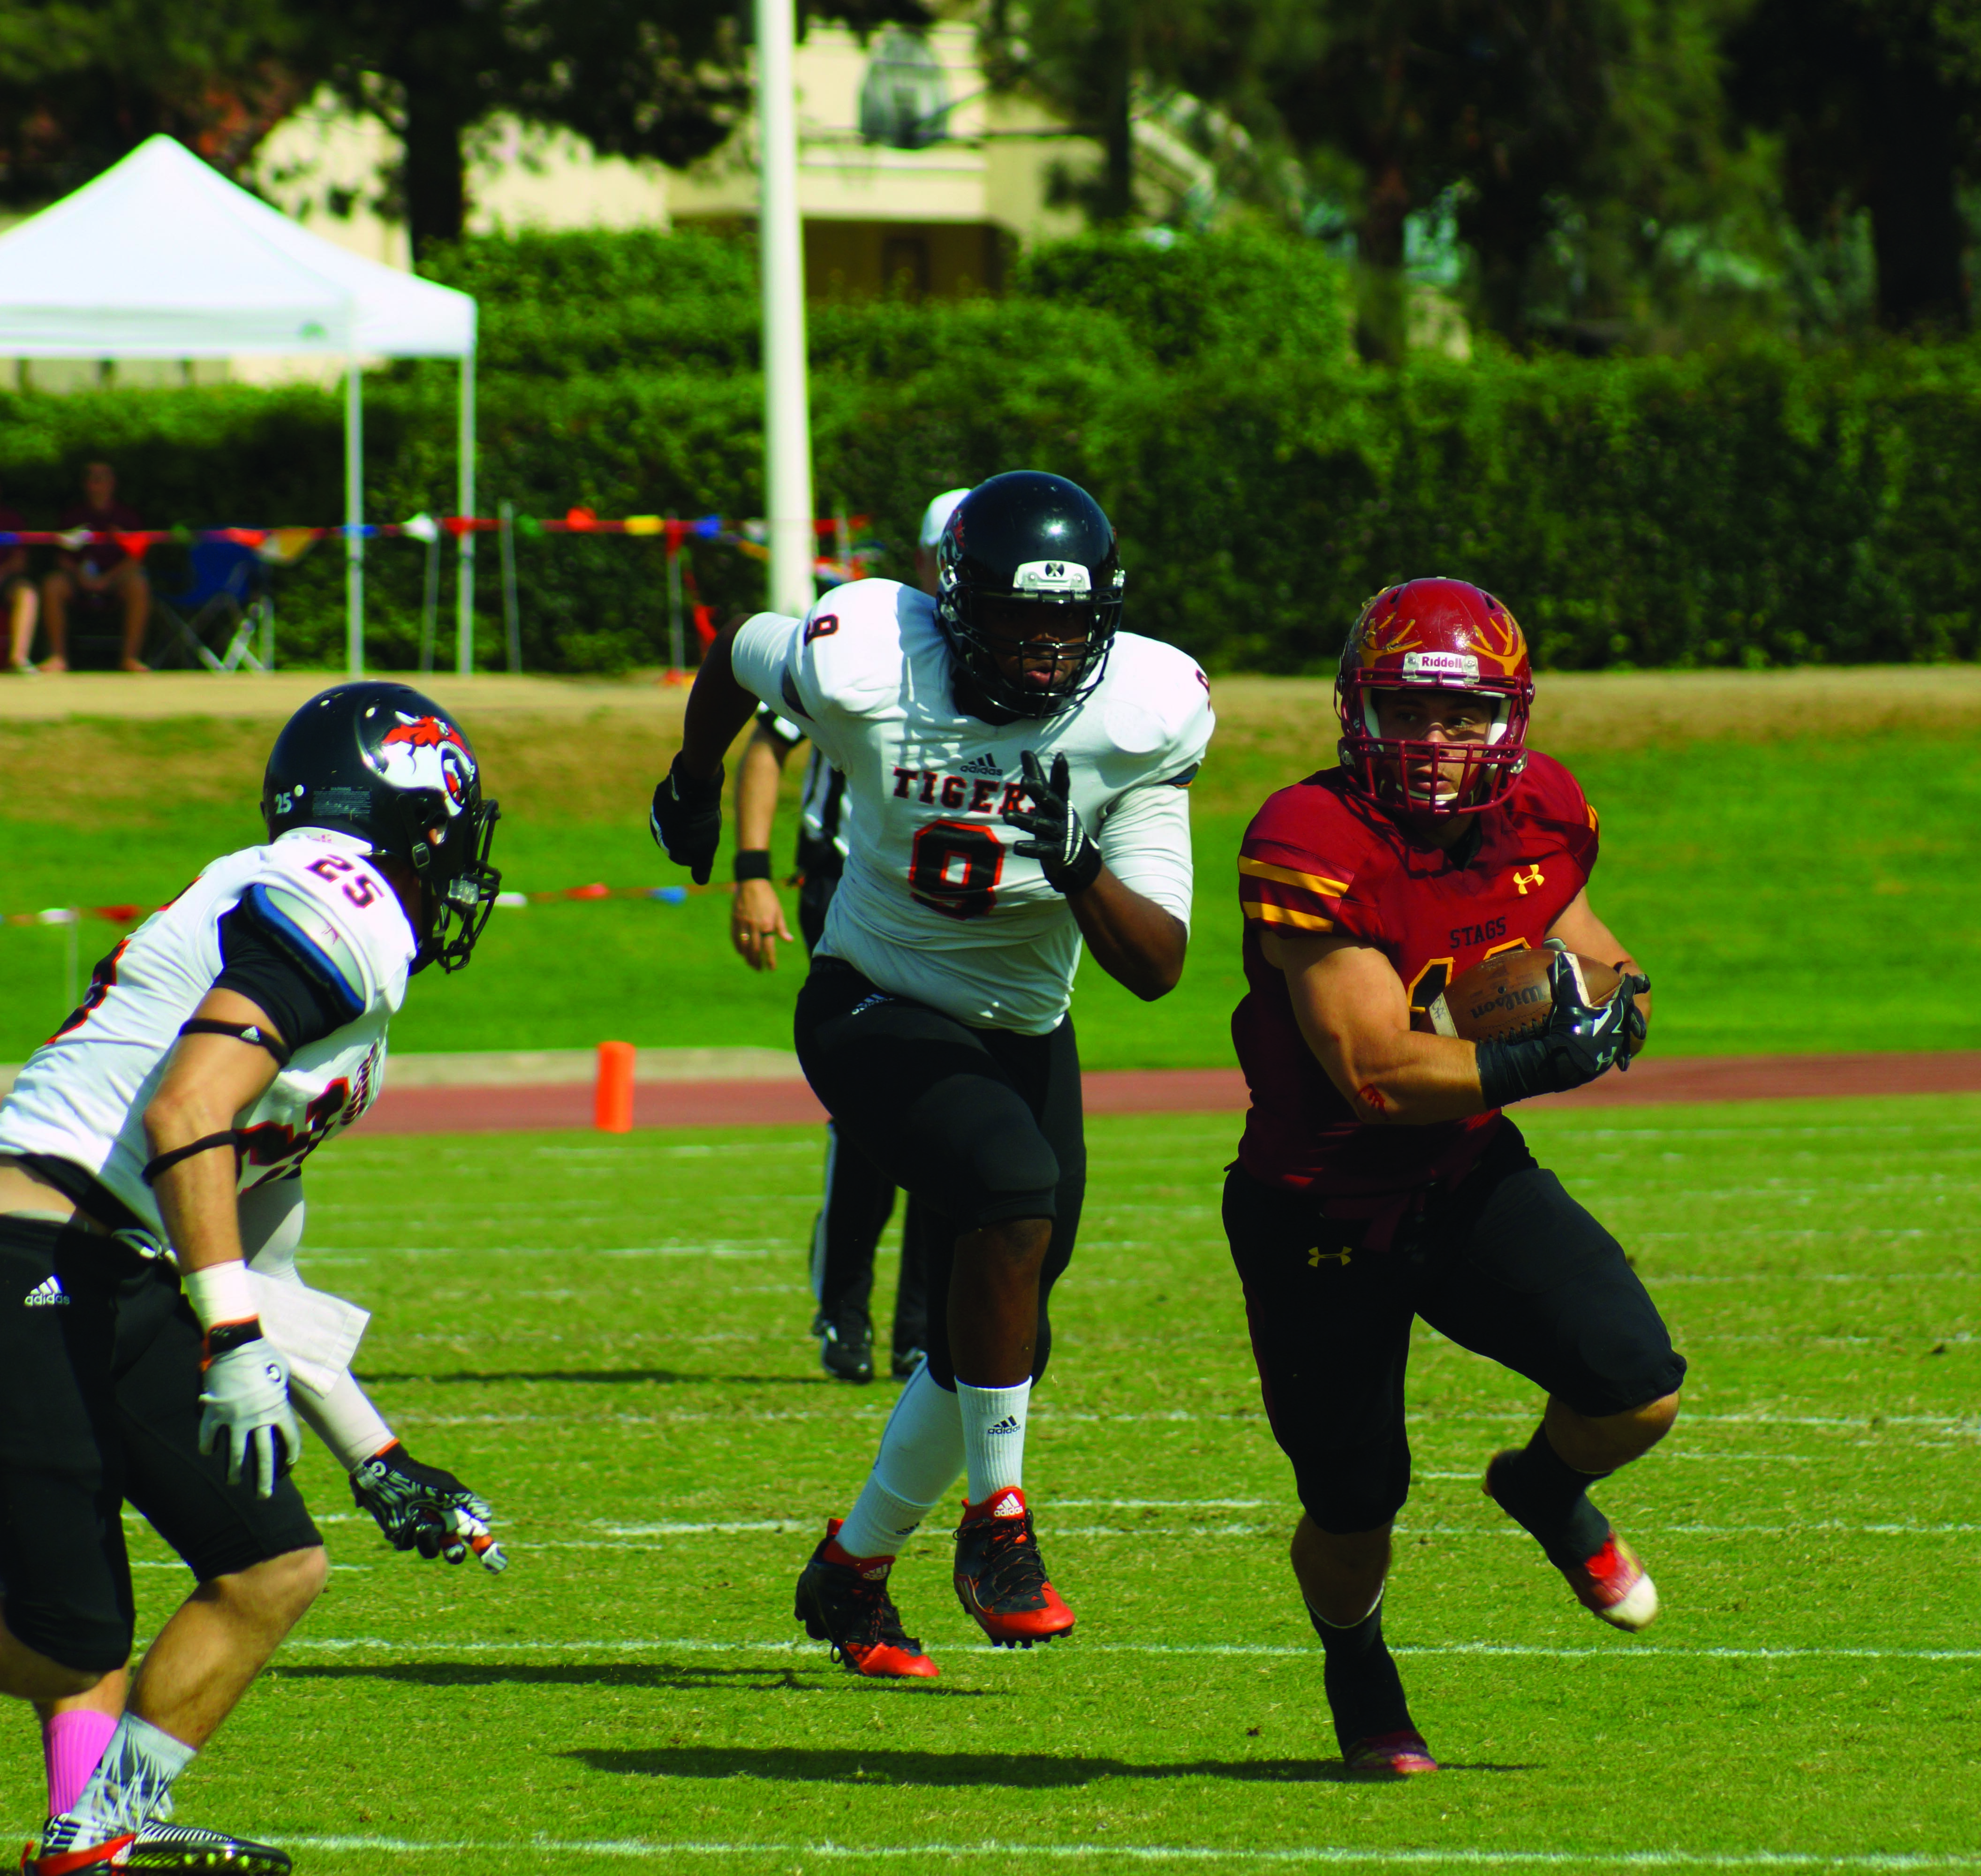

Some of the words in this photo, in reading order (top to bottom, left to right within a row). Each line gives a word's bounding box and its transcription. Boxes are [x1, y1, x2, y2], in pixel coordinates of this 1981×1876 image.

[1422, 656, 1462, 668] Riddell
[960, 765, 1003, 777] adidas
[893, 766, 1036, 816] TIGER
[275, 792, 292, 815] 25
[304, 854, 385, 908] 25
[908, 819, 1006, 921] 9
[1450, 916, 1506, 949] STAGS
[1470, 985, 1545, 1019] Wilson
[24, 1292, 70, 1307] adidas
[987, 1424, 1021, 1434] adidas
[994, 1506, 1023, 1517] adidas
